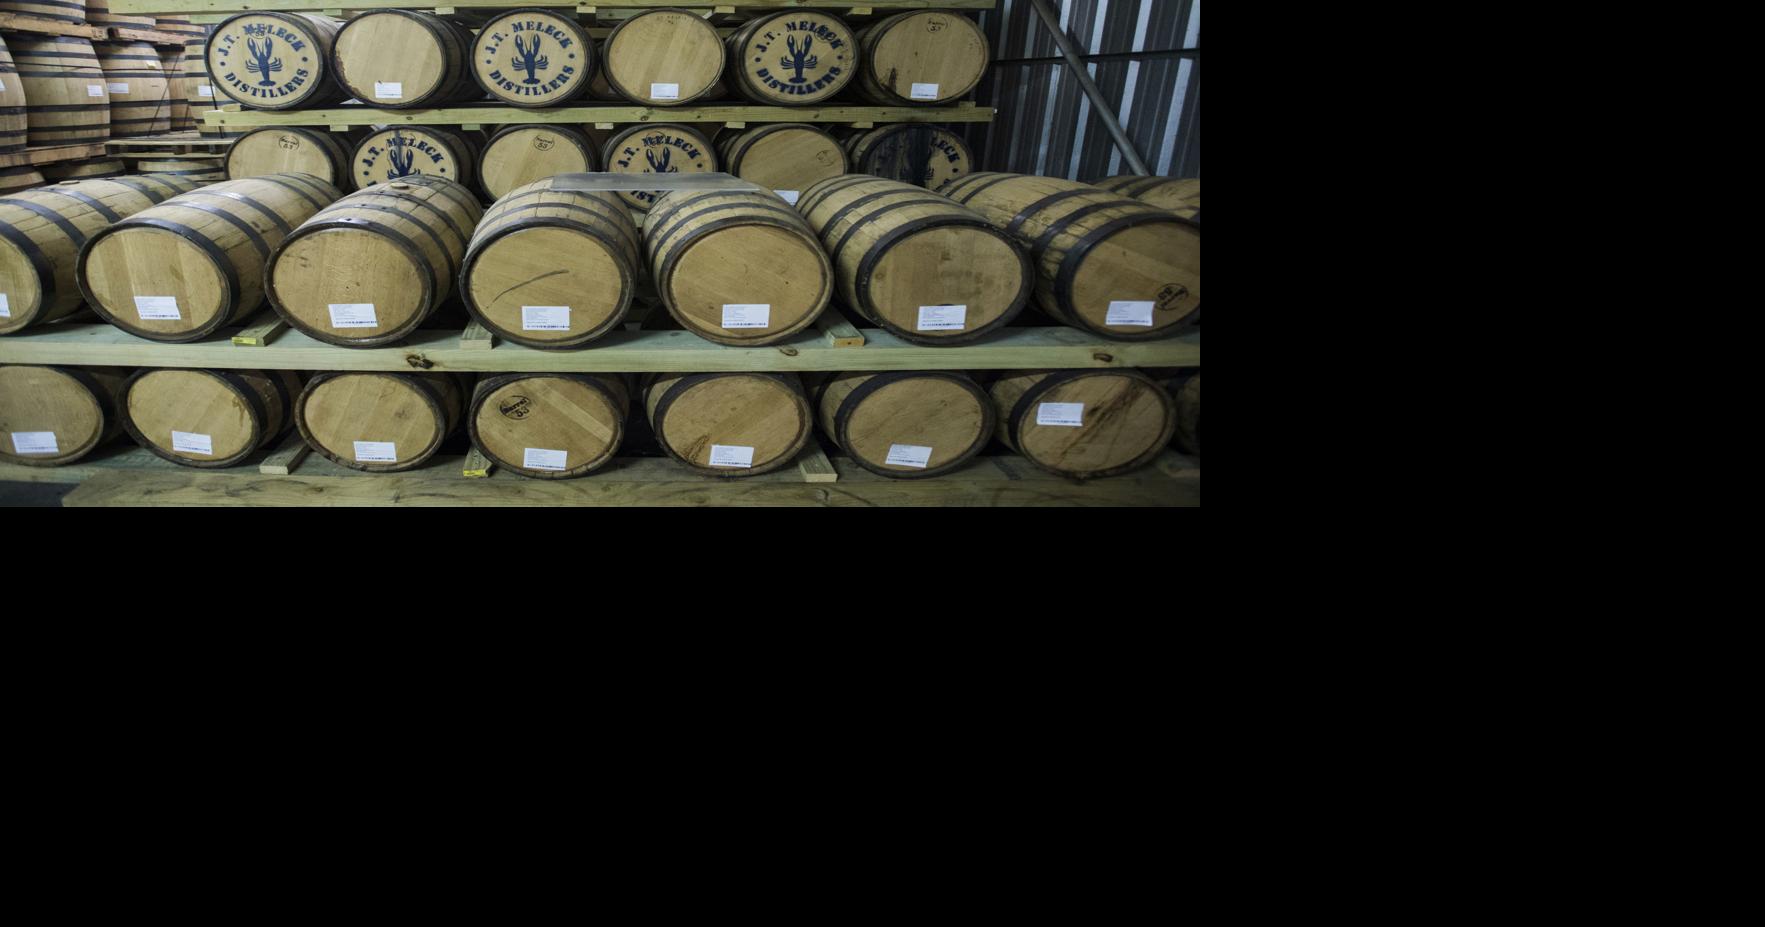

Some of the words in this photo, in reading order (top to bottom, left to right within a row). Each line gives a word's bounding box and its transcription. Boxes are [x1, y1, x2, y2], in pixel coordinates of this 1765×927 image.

[218, 34, 240, 56] J.T.
[243, 23, 306, 52] MELECK
[485, 32, 509, 54] J.T.
[512, 21, 573, 48] MELECK
[756, 32, 781, 52] J.T.
[785, 21, 843, 49] MELECK
[224, 69, 308, 98] DISTILLERS
[489, 65, 574, 96] DISTILLERS
[756, 66, 841, 95] DISTILLERS
[362, 146, 384, 167] J.T.
[387, 136, 444, 163] MELECK
[618, 147, 640, 168] J.T.
[642, 136, 701, 159] MELECK
